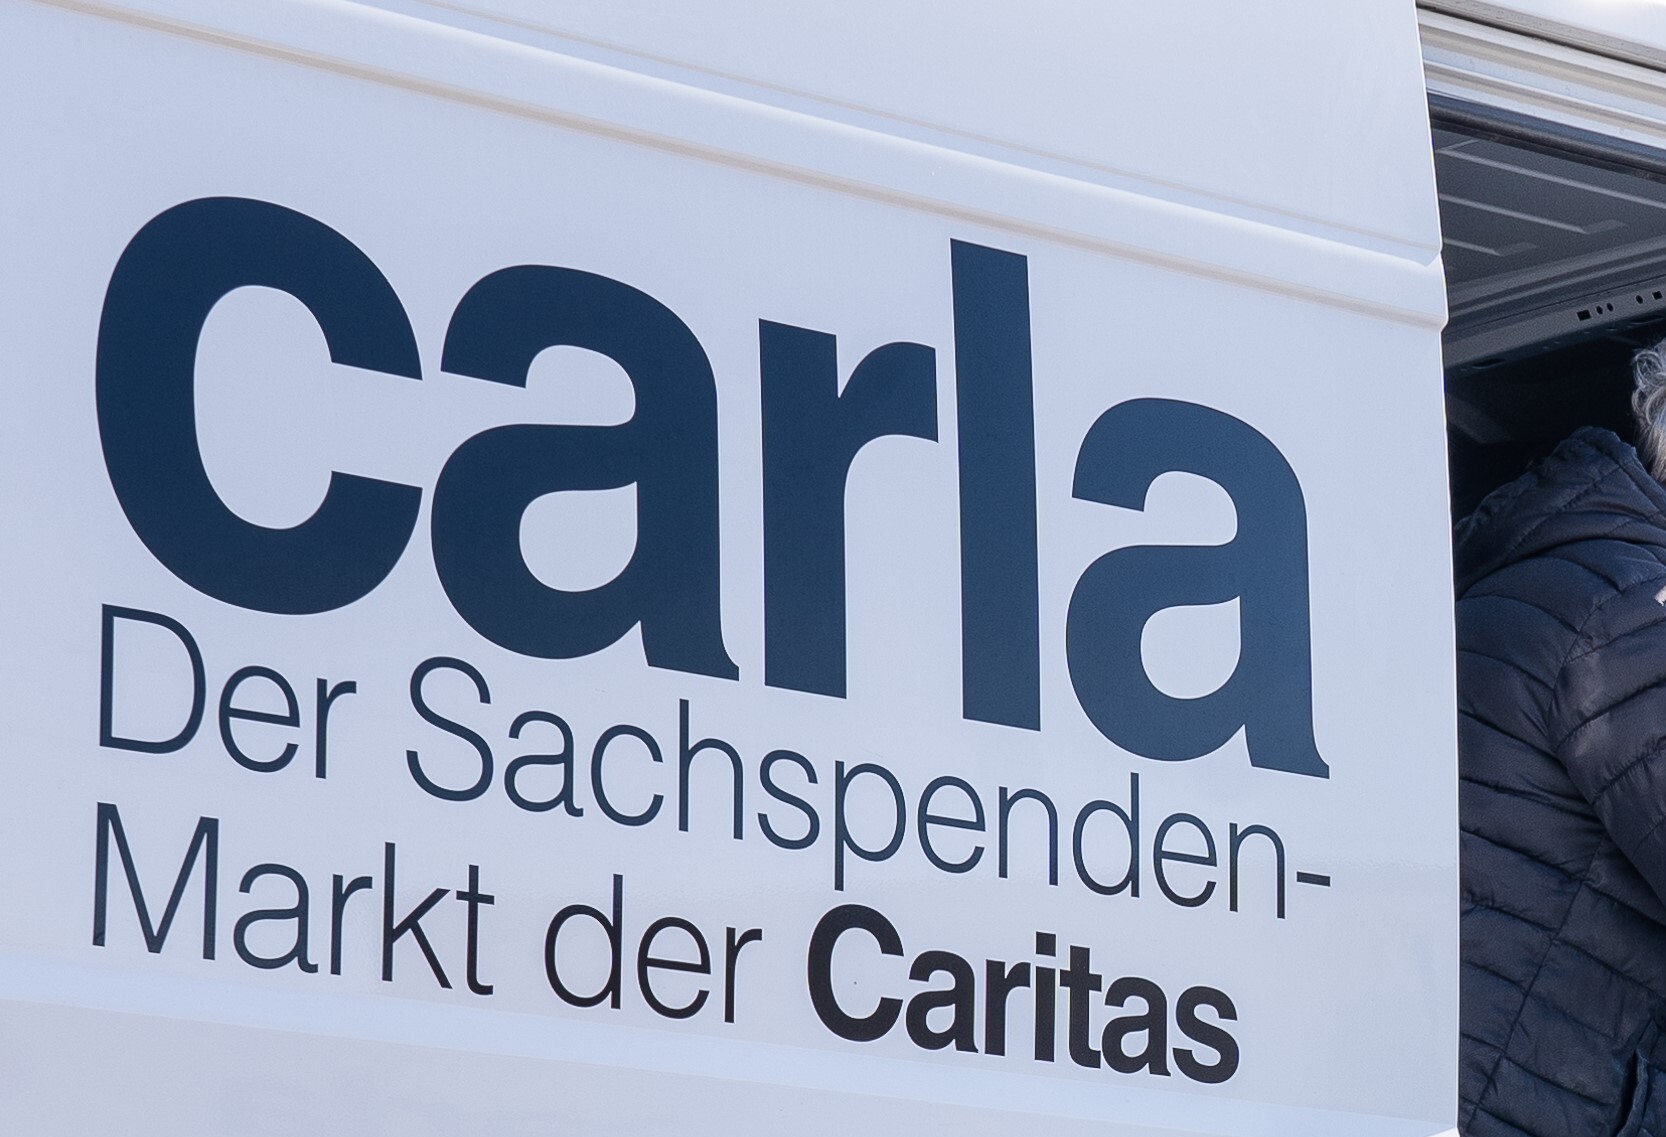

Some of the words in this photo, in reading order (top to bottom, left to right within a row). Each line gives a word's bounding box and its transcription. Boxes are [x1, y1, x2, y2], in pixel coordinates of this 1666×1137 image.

[96, 197, 1329, 780] carla
[100, 604, 357, 780] Der
[405, 656, 1331, 920] Sachspenden-
[92, 801, 495, 996] Markt
[544, 873, 763, 1024] der
[807, 904, 1240, 1085] Caritas
